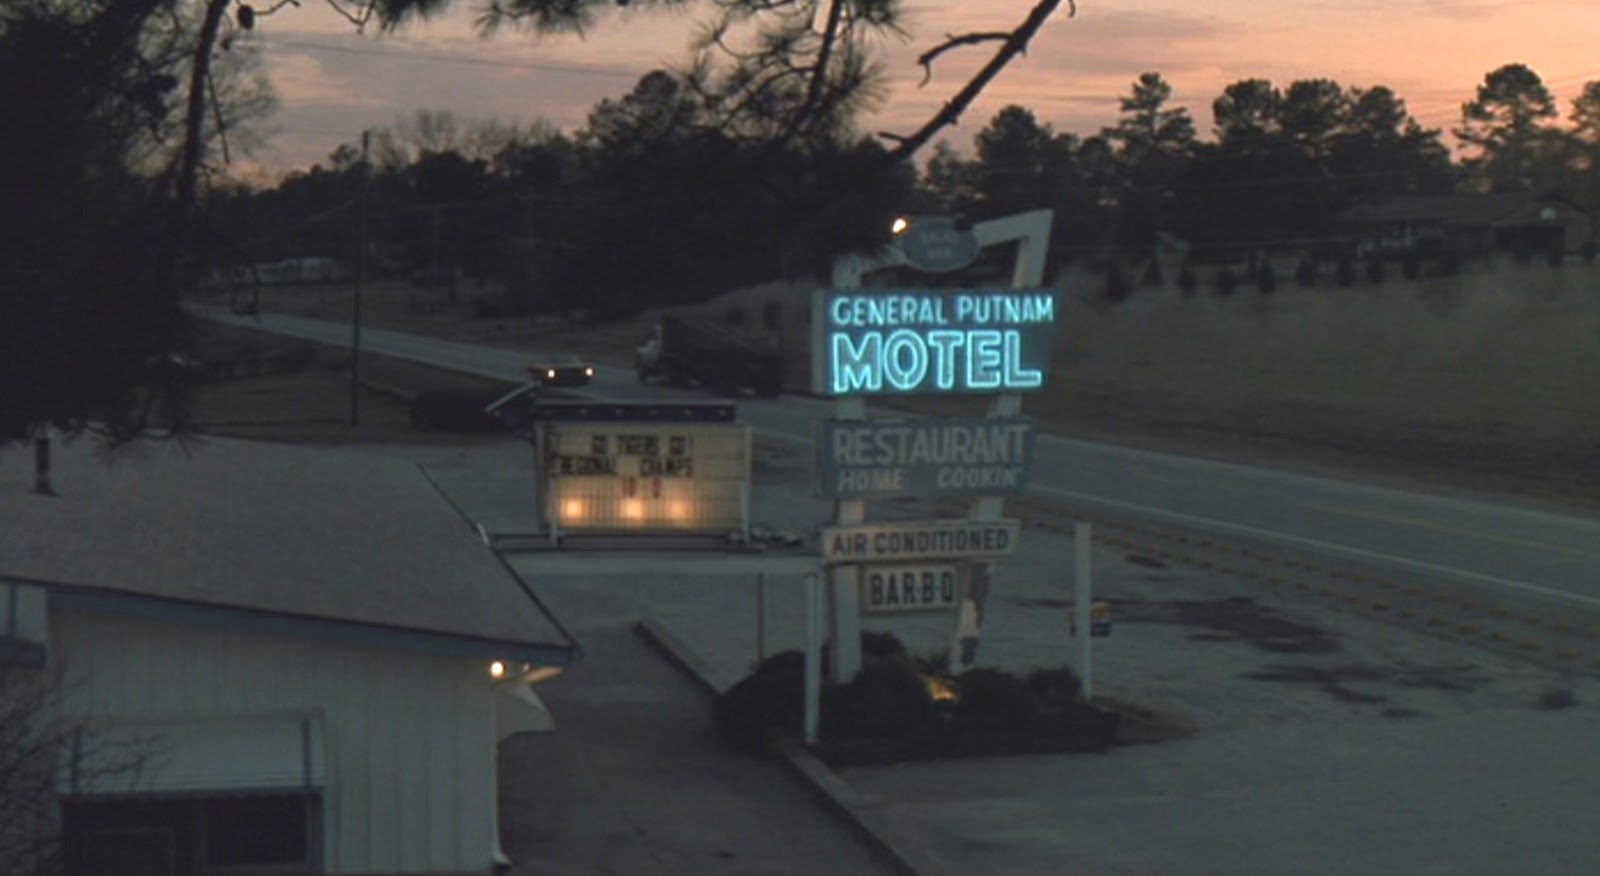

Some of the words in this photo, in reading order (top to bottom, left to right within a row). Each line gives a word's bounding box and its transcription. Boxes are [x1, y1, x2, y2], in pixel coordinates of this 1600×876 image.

[832, 296, 948, 325] GENERAL
[957, 295, 1053, 323] PUTNAM
[832, 329, 1042, 392] MOTEL
[833, 425, 1029, 465] RESTAURANT
[837, 468, 905, 492] HOME
[833, 533, 867, 555] AIR
[874, 529, 1009, 554] CONDITIONED
